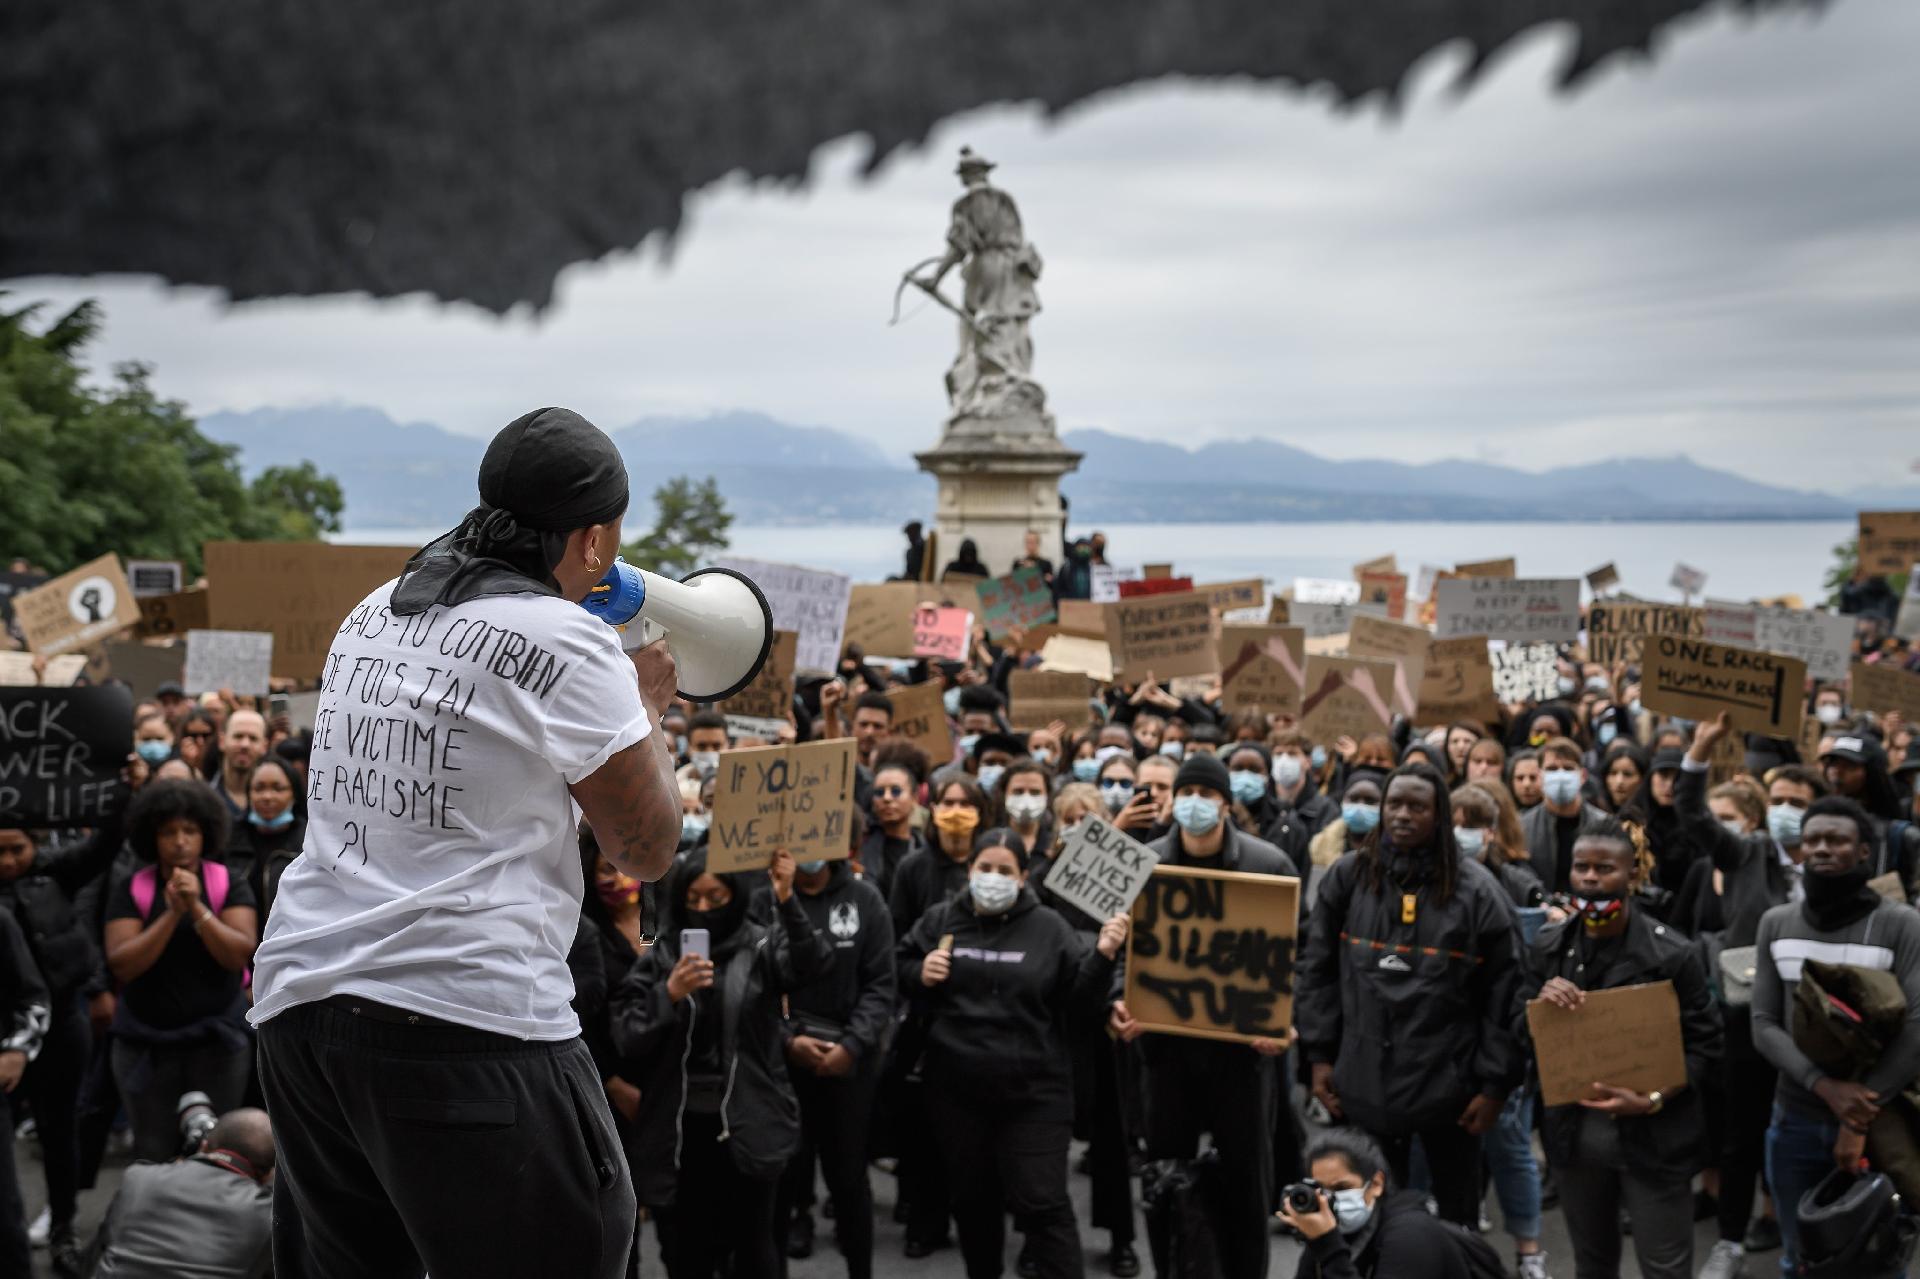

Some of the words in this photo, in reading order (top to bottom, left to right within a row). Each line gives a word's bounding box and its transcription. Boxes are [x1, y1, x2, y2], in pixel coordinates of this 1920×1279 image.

[1451, 613, 1574, 633] INNOCENTE
[339, 604, 439, 648] SAIS-TU
[440, 618, 569, 700] COMBIEN
[1590, 637, 1644, 663] LIVES
[1659, 636, 1718, 668] ONE
[1724, 651, 1778, 673] RACE
[321, 652, 347, 696] DE
[346, 657, 408, 707] FOIS
[409, 664, 476, 720] J'AI
[1657, 666, 1731, 691] HUMAN
[312, 700, 337, 751] ÉTÉ
[347, 712, 469, 776] VICTIME
[48, 778, 118, 822] LIFE
[308, 751, 326, 802] DE
[332, 765, 465, 831] RACISME
[757, 758, 801, 794] YOU
[758, 797, 785, 815] with
[791, 791, 815, 813] US
[719, 818, 760, 849] WE
[1084, 819, 1149, 872] BLACK
[1054, 864, 1126, 916] MATTER
[1070, 845, 1136, 894] LIVES
[1139, 877, 1225, 926] TON
[1135, 971, 1287, 1036] TUE
